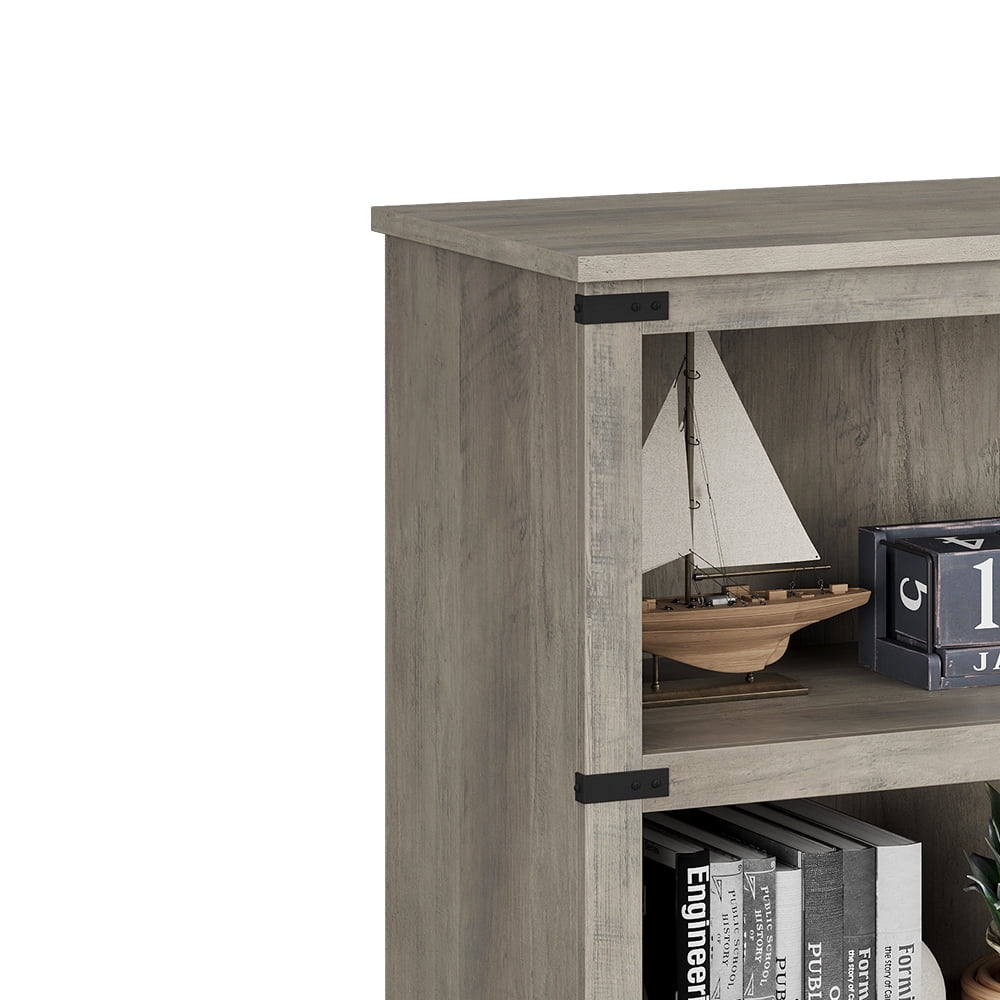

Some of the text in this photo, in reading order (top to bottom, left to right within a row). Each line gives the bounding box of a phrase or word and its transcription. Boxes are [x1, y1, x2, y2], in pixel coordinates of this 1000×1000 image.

[973, 557, 1000, 630] 1
[722, 913, 731, 967] HISTORY
[726, 889, 740, 990] PUBLIC SCHOOL
[754, 909, 764, 964] HISTORY
[759, 885, 774, 986] PUBLIC SCHOOL
[885, 946, 893, 959] the
[848, 984, 855, 992] of
[885, 979, 893, 987] of
